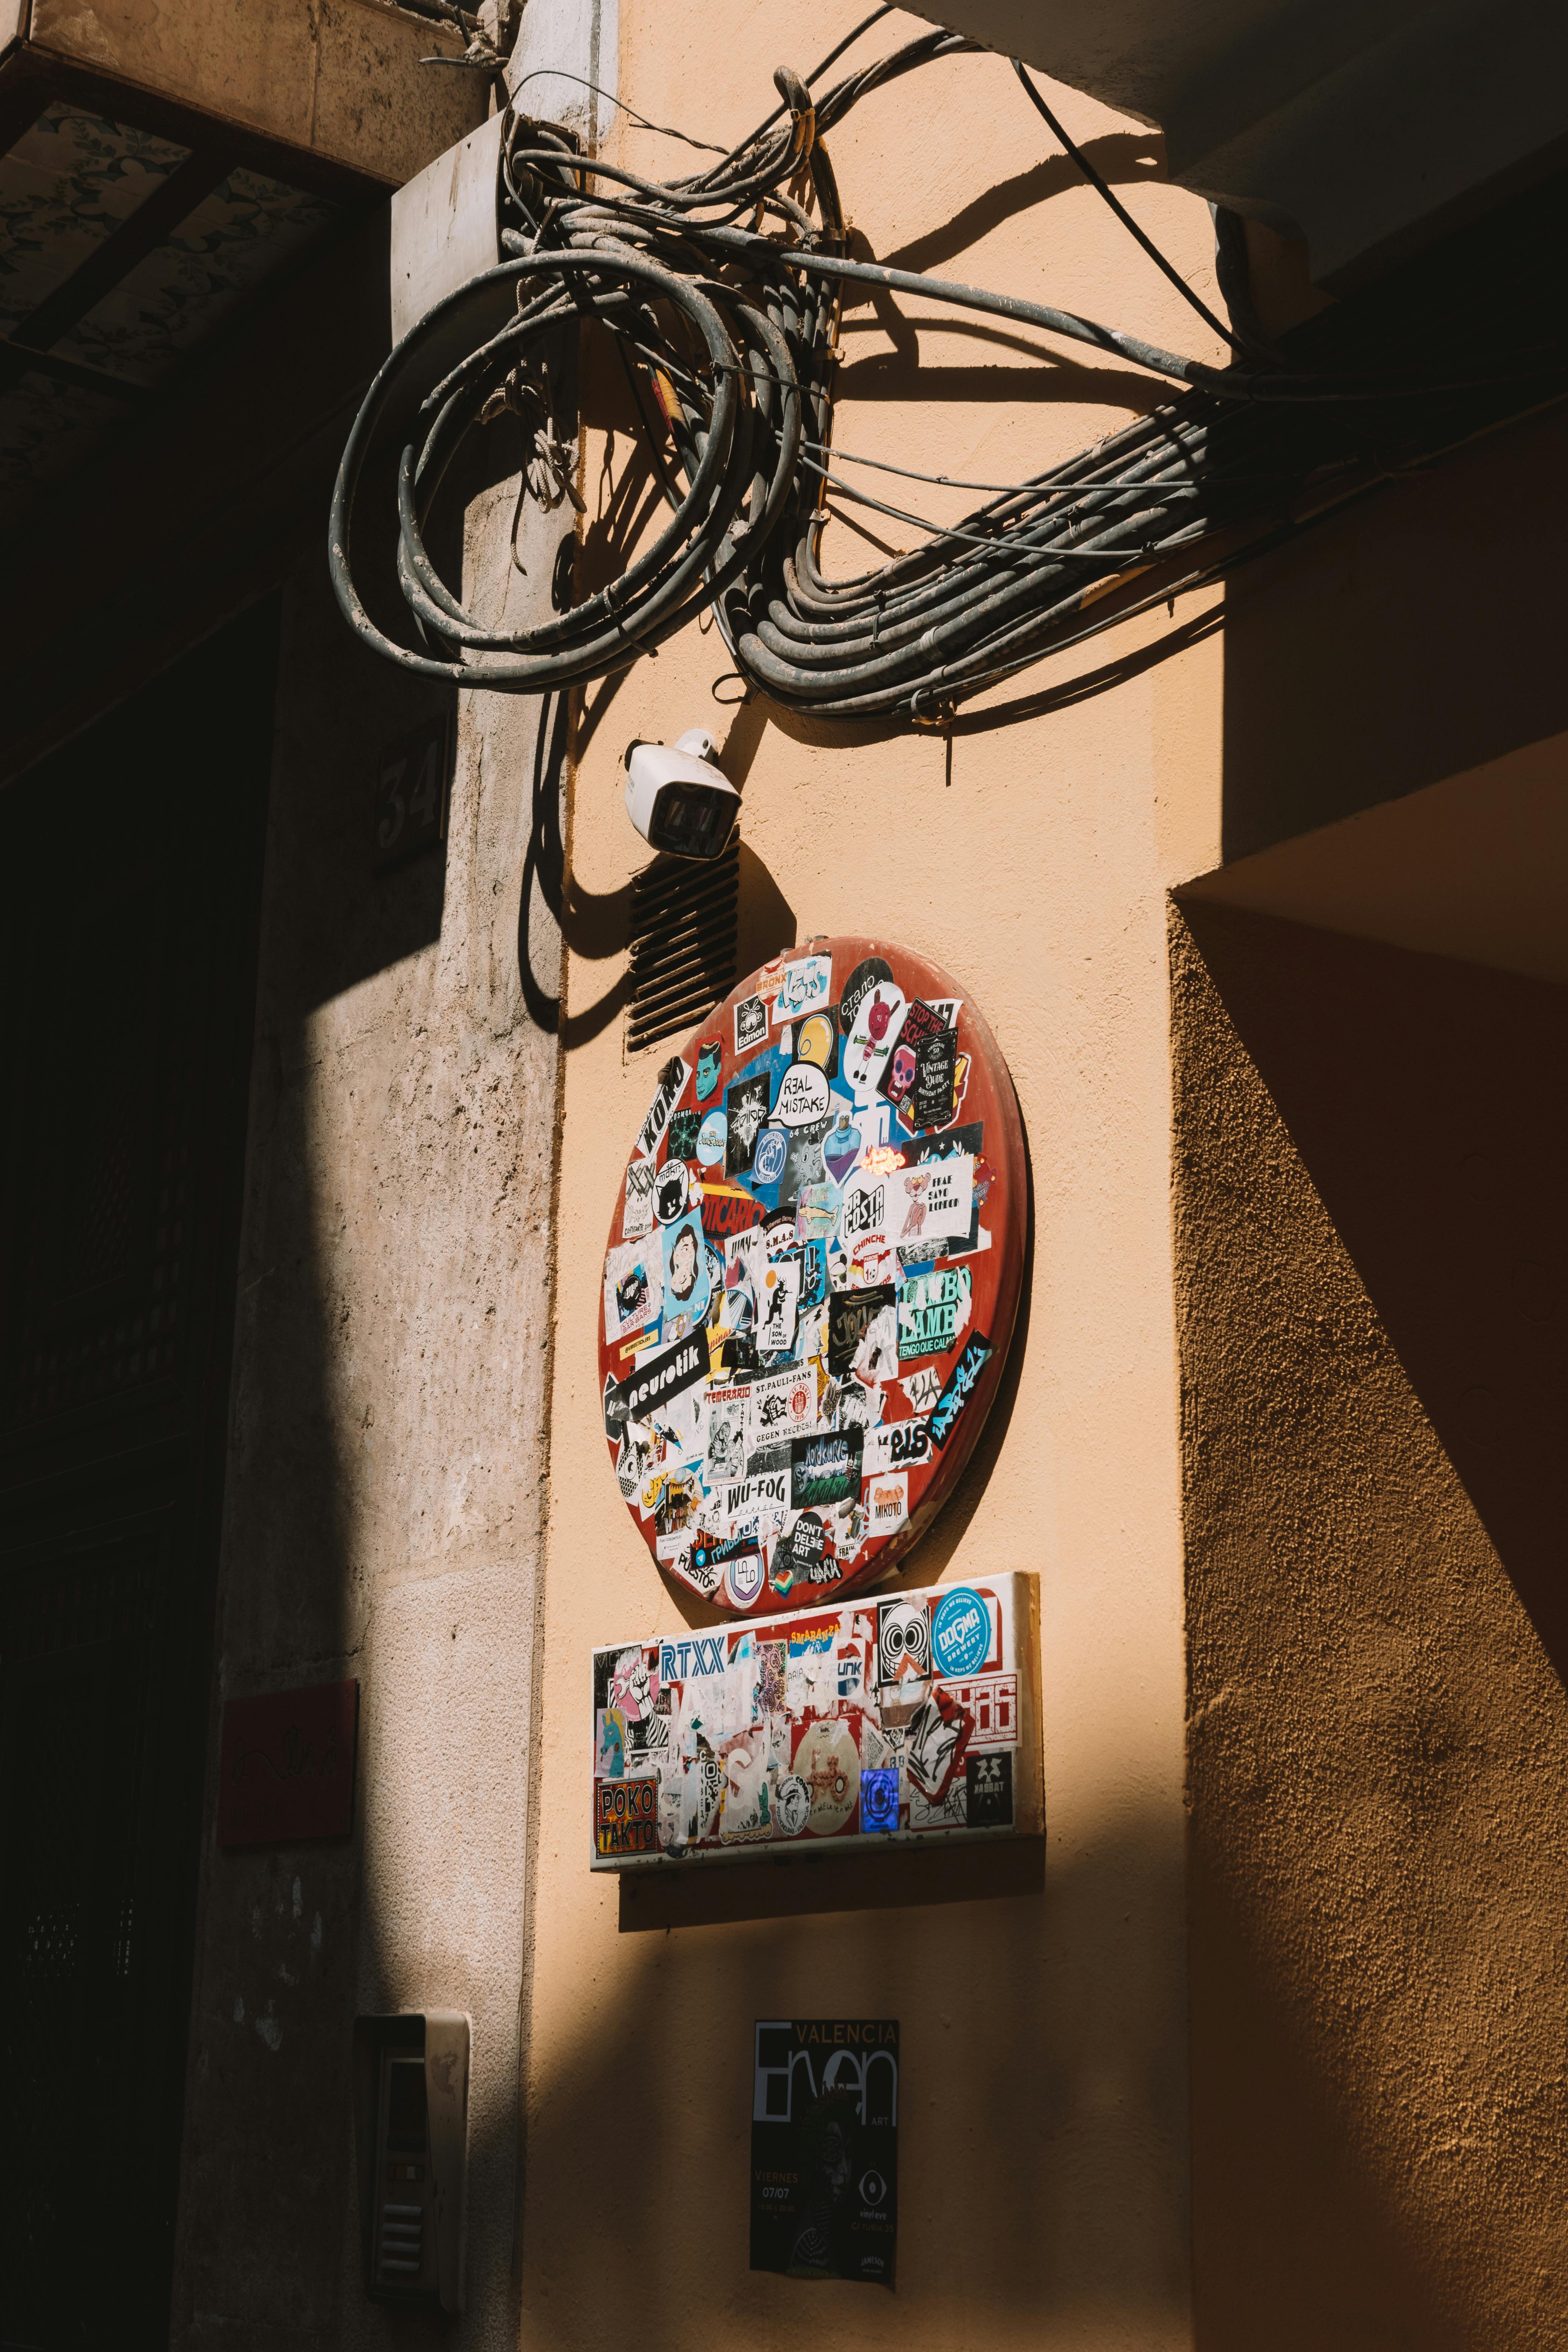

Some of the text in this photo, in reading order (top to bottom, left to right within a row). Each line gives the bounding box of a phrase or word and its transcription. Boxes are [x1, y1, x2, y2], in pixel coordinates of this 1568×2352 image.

[378, 740, 439, 849] 34
[756, 973, 787, 992] BRONX
[910, 1003, 928, 1024] STOP
[928, 1015, 944, 1032] THE
[738, 1027, 765, 1048] Edmon
[928, 1042, 945, 1052] ORIGINAL
[920, 1060, 948, 1078] VINTAGE
[784, 1075, 812, 1095] REAL
[918, 1080, 950, 1096] BIRTHDAY PARTY
[926, 1073, 944, 1089] DUDE
[778, 1096, 825, 1115] MISTAKE
[789, 1121, 828, 1138] 64 CREW
[933, 1175, 952, 1187] FRAE
[929, 1198, 959, 1212] LONDON
[853, 1234, 886, 1256] CHINCHE
[864, 1254, 878, 1262] PARCHE
[622, 1305, 647, 1328] CULTURE
[623, 1308, 651, 1333] BAR-BARS
[900, 1304, 957, 1344] LAMB
[899, 1343, 920, 1357] TENGO
[920, 1340, 933, 1351] QUE
[629, 1345, 699, 1409] neurotik
[707, 1386, 750, 1404] TEMERARIO
[799, 1384, 810, 1400] PAULI
[756, 1430, 779, 1442] GEGEN
[728, 1475, 785, 1515] WU-FOG
[739, 1504, 773, 1516] GARAGE
[875, 1501, 901, 1519] MIKOTO
[796, 1520, 823, 1538] DON'T
[792, 1543, 810, 1557] ART
[940, 1607, 949, 1621] HOPS
[949, 1599, 956, 1608] WE
[791, 1623, 842, 1645] SMARANZA
[938, 1608, 980, 1652] DOGMA
[947, 1633, 980, 1663] BREWERY
[971, 1643, 983, 1665] BELIEVE
[662, 1636, 725, 1681] RTXX
[796, 1776, 809, 1803] COMIC
[602, 1784, 654, 1819] POKO
[796, 1805, 809, 1832] VALENCIA
[600, 1818, 654, 1850] TAKTO
[796, 2024, 896, 2043] VALENCIA
[871, 2117, 888, 2126] ART
[754, 2170, 798, 2183] VIERNES
[763, 2187, 789, 2199] 07/07
[859, 2208, 887, 2220] vinyl eye
[851, 2222, 860, 2230] C/
[862, 2223, 882, 2232] TURIA
[861, 2256, 884, 2267] JAMESON
